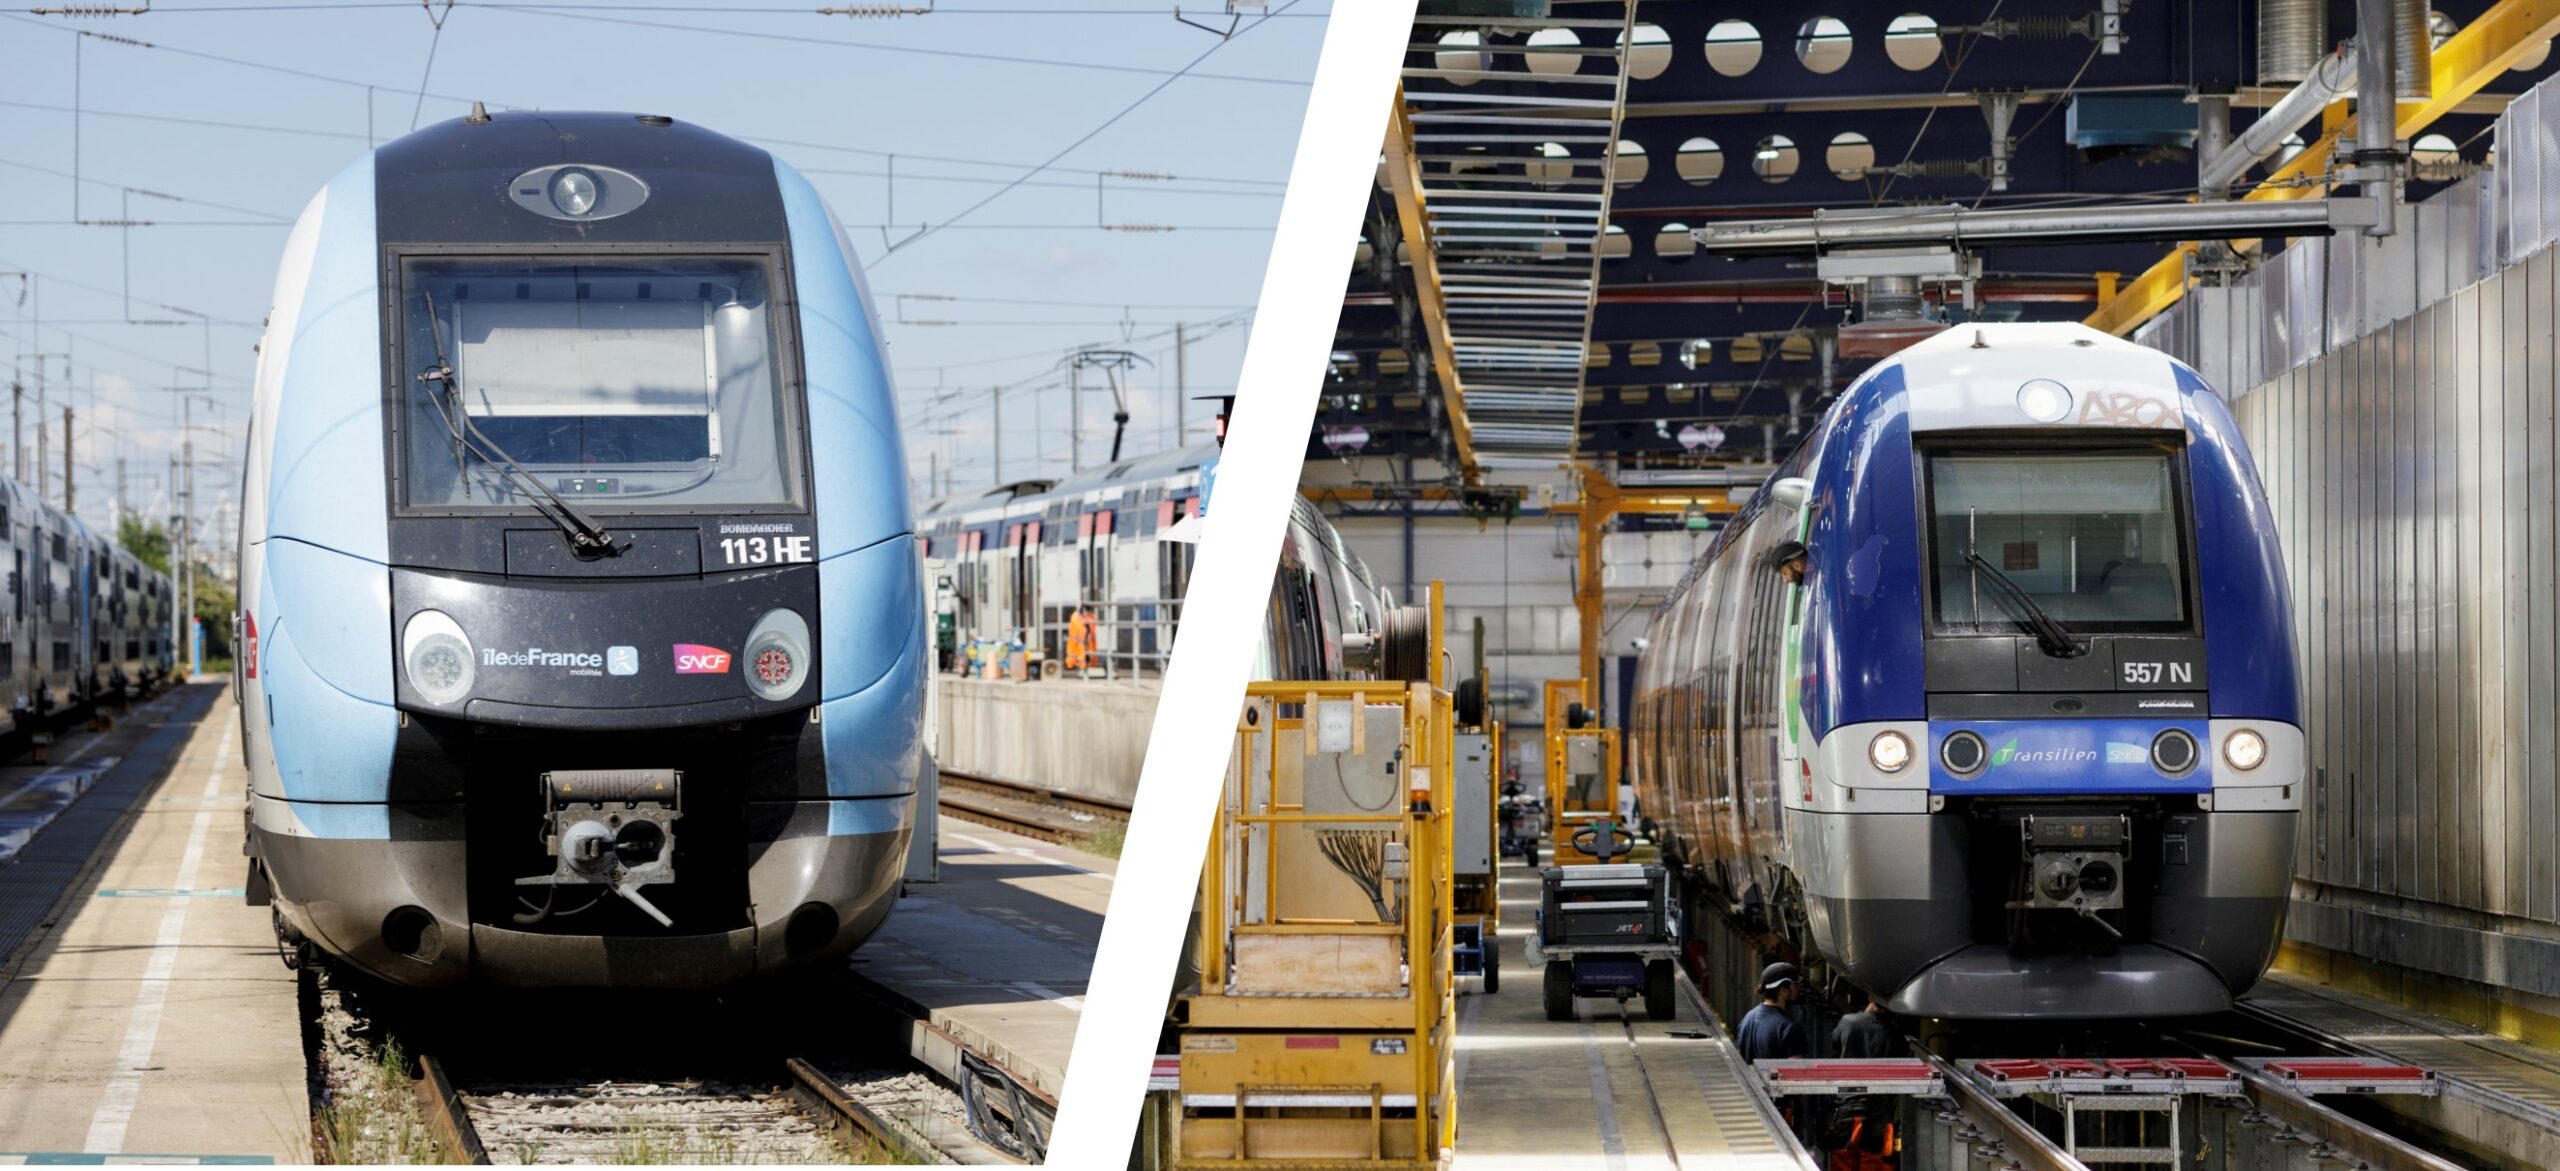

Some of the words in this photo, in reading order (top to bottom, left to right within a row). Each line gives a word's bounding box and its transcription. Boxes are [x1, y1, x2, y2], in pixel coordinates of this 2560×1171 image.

[720, 523, 793, 534] BOMBARDIER
[720, 537, 768, 564] 113
[773, 536, 813, 563] HE
[678, 654, 727, 670] SNCF
[570, 668, 602, 676] mobilités
[2124, 662, 2163, 683] 557
[2169, 662, 2192, 683] N
[2001, 748, 2097, 761] Transilien
